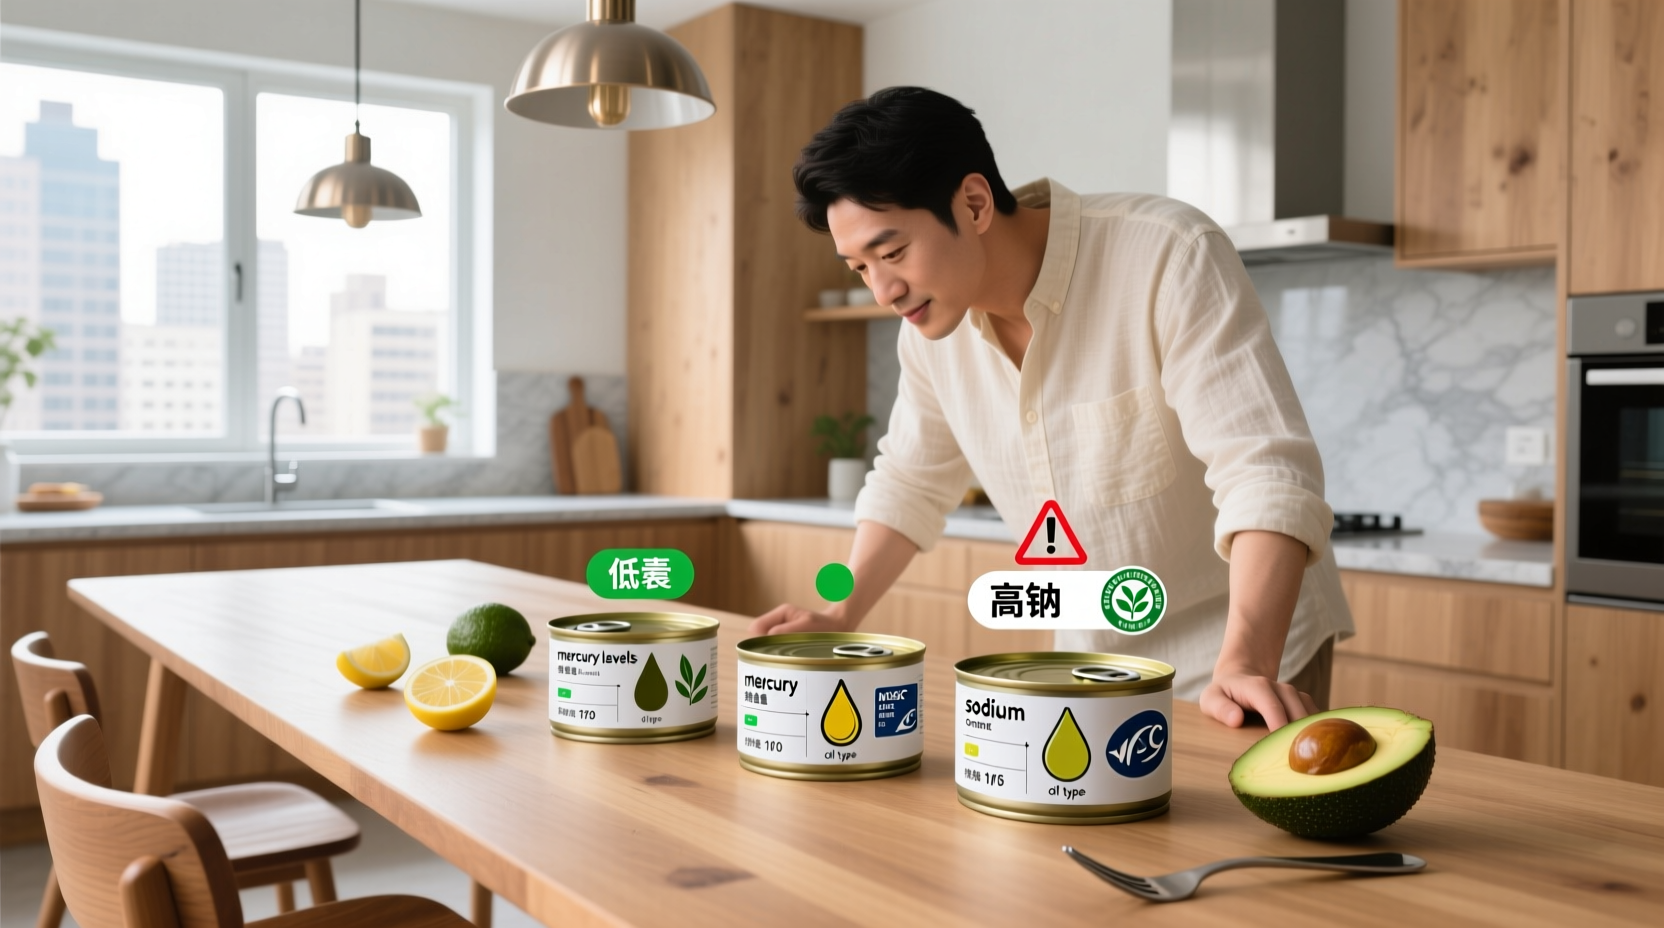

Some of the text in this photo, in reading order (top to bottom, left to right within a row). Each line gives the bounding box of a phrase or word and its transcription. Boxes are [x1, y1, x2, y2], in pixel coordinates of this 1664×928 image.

[557, 650, 638, 666] mercury levels
[744, 674, 798, 697] mercury
[965, 697, 1025, 721] sodium
[1063, 787, 1086, 800] type
